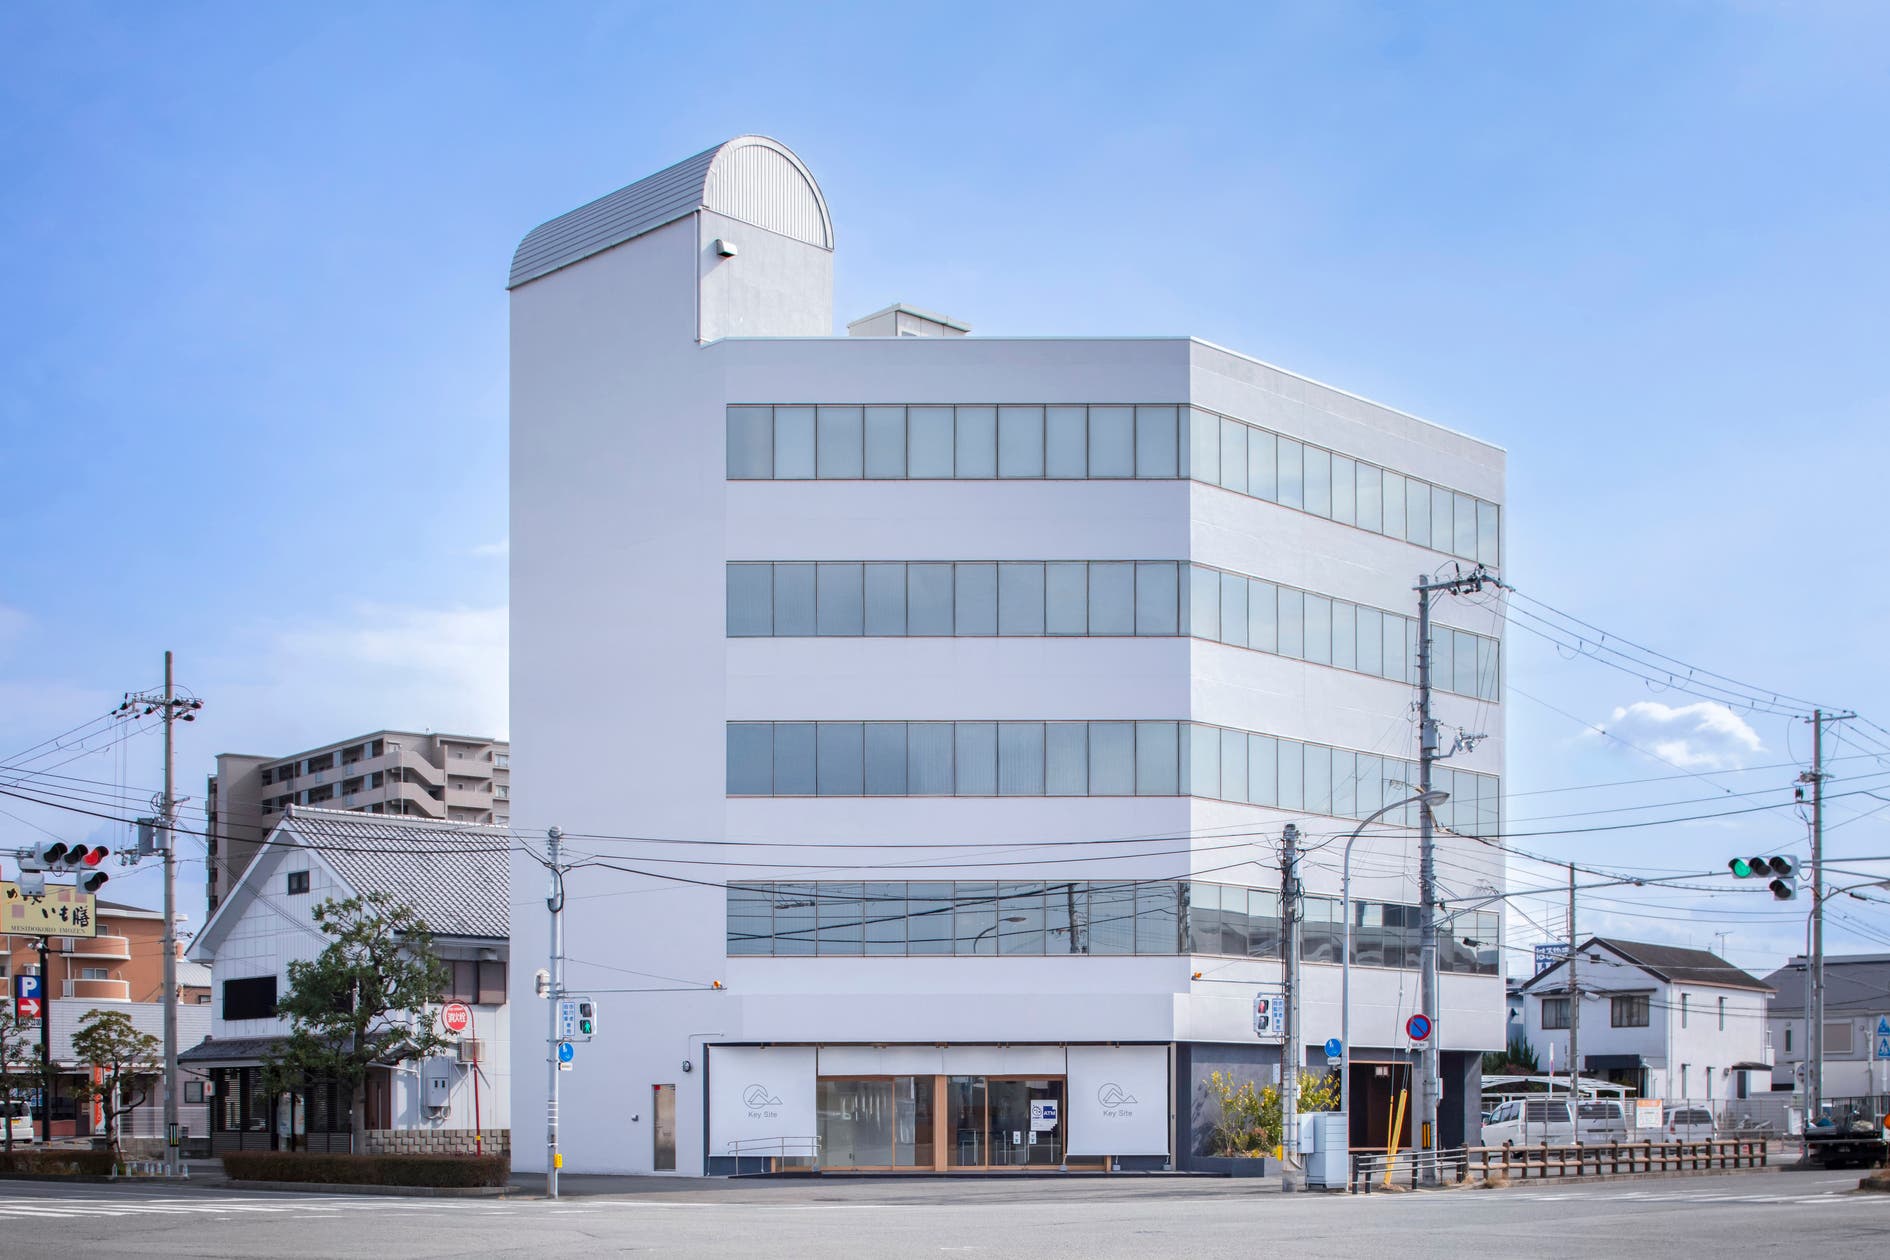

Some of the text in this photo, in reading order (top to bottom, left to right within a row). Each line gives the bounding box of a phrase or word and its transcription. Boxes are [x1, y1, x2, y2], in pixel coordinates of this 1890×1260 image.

[22, 977, 37, 997] P
[748, 1111, 761, 1119] Key
[1103, 1109, 1133, 1118] Key Site
